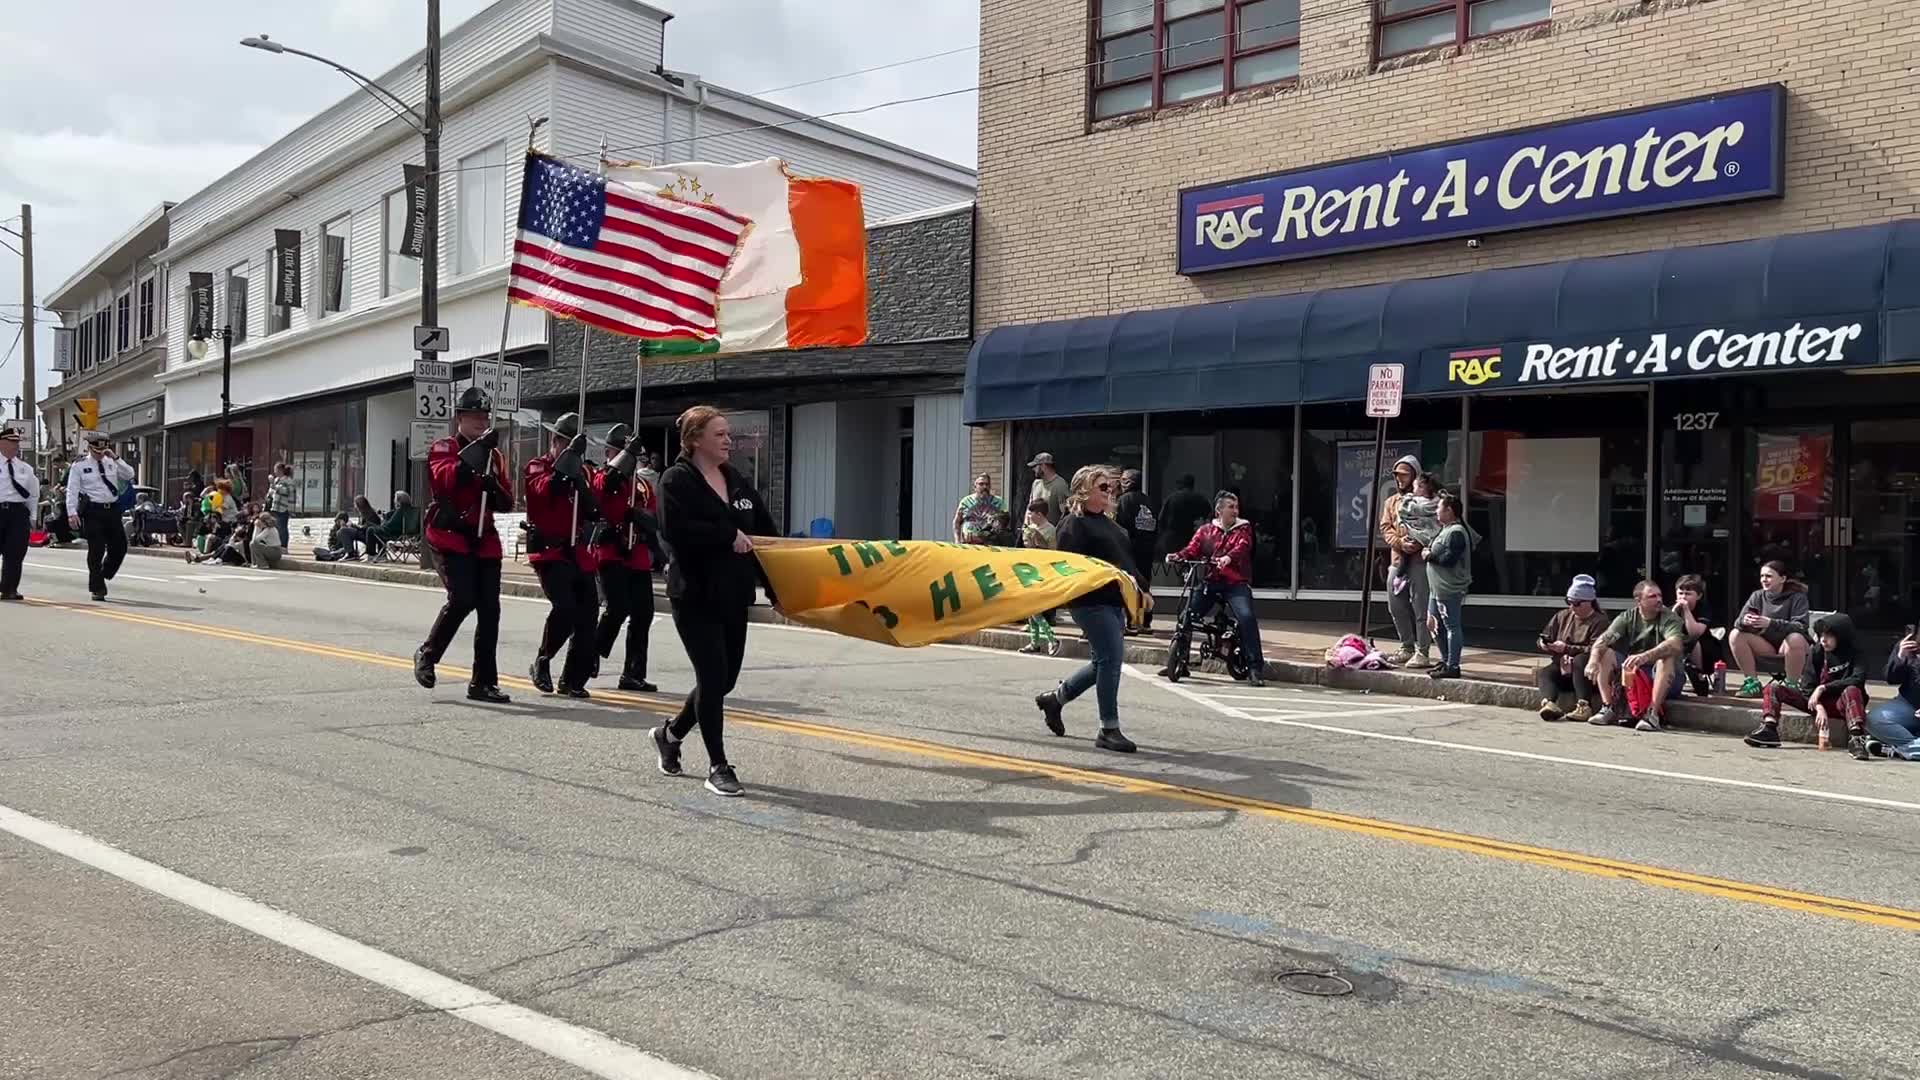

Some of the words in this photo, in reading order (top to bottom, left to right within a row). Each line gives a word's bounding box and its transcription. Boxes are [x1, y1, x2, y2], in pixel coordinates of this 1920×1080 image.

[1195, 205, 1264, 250] RAC
[419, 363, 448, 377] SOUTH
[476, 366, 497, 376] RIGHT
[503, 369, 517, 378] ANE
[1380, 369, 1393, 379] NO
[1448, 355, 1502, 386] RAC
[1371, 380, 1400, 390] PARKING
[1371, 390, 1388, 398] HERE
[420, 395, 447, 417] 33
[1371, 398, 1397, 406] CORNER
[1673, 412, 1719, 431] 1237
[1355, 449, 1376, 460] STAR
[1663, 487, 1699, 495] Additional
[1699, 487, 1727, 496] Parking
[1699, 494, 1727, 503] Building
[827, 540, 908, 576] THE
[929, 560, 1087, 621] HERE
